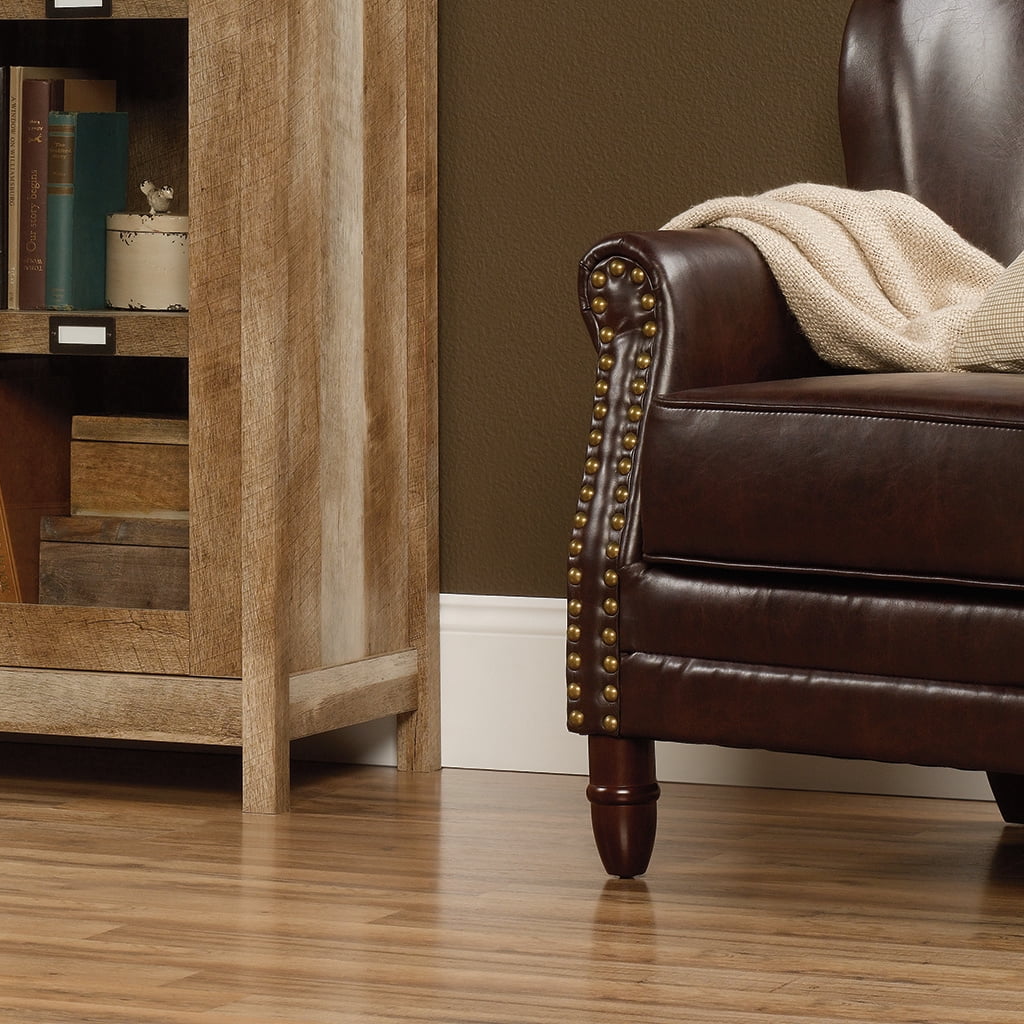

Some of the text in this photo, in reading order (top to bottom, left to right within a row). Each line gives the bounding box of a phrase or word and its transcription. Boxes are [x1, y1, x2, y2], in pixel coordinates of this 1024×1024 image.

[26, 168, 41, 200] begins
[28, 202, 40, 228] story
[25, 230, 37, 253] Our
